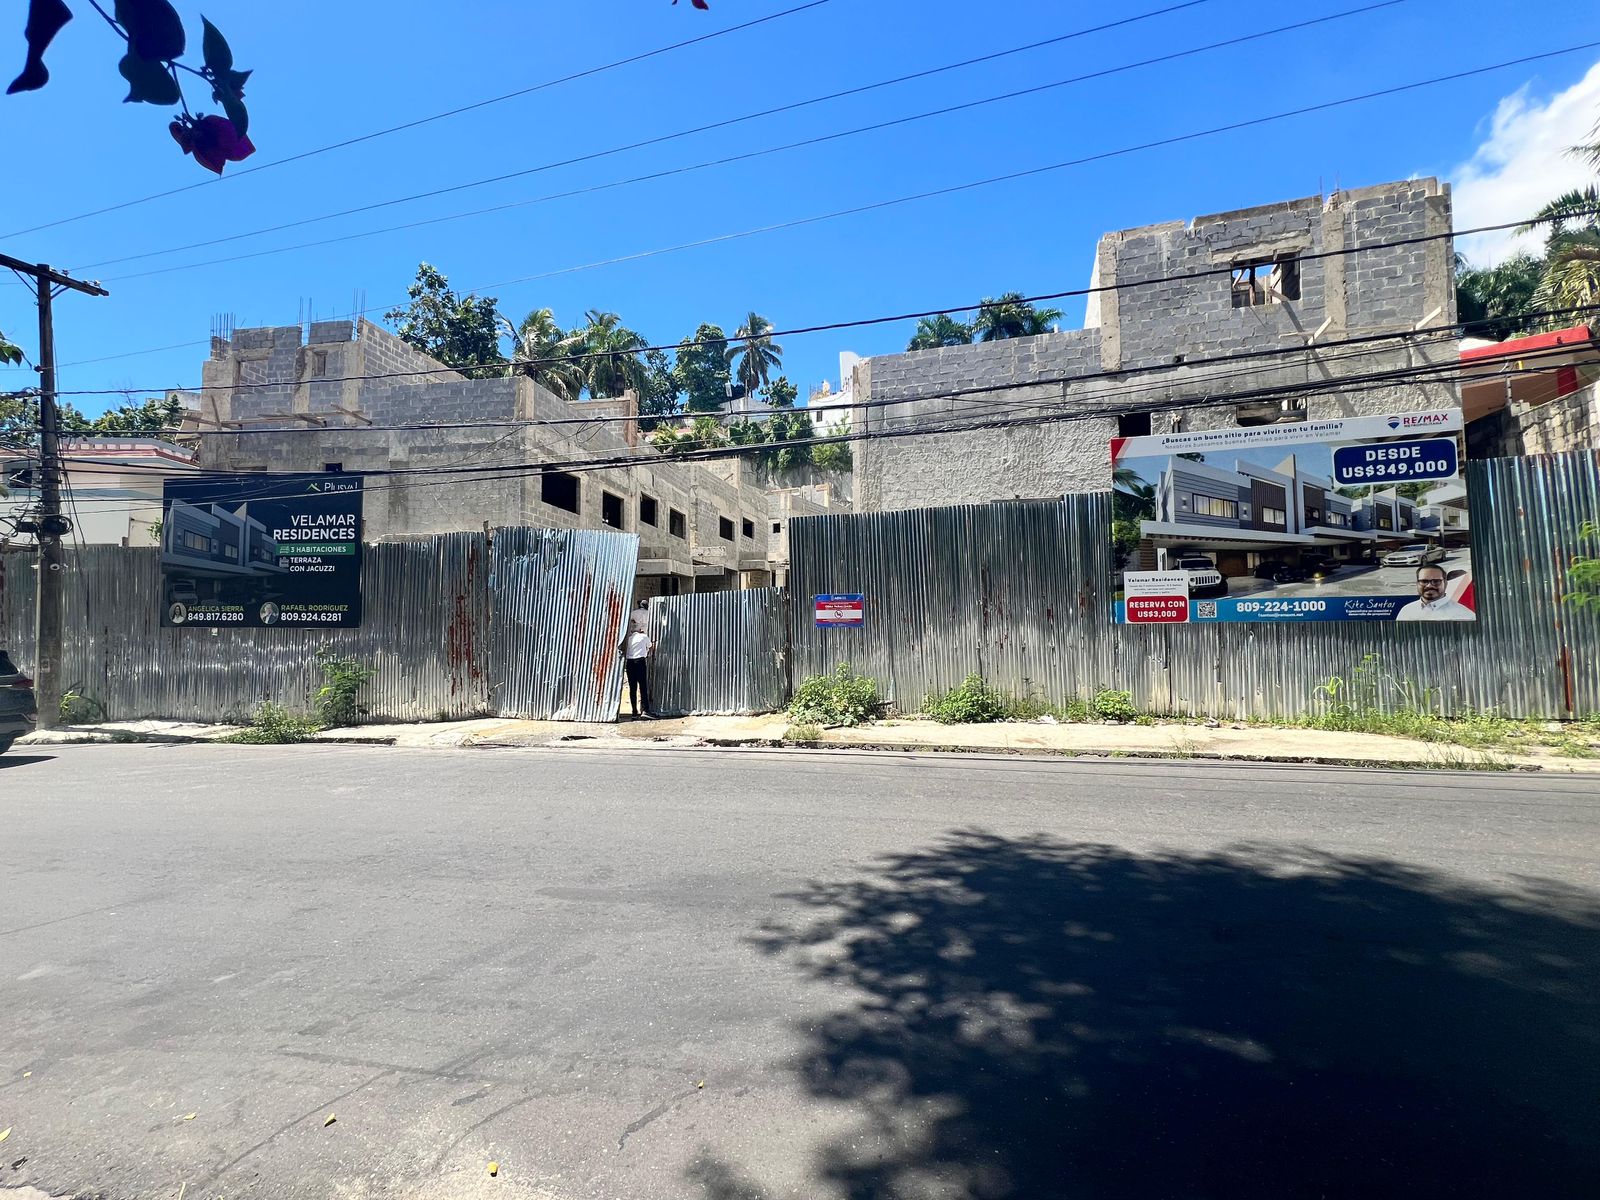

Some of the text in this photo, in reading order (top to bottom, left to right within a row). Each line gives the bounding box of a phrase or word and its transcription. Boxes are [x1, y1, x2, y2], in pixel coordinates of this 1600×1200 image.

[1403, 413, 1448, 425] RE/MAX
[1310, 422, 1343, 431] familia?
[1365, 446, 1421, 461] DESDE
[1342, 459, 1447, 478] US$349,000
[291, 514, 356, 526] VELAMAR
[273, 528, 355, 540] RESIDENCES
[1129, 600, 1185, 609] RESERVA CON
[1236, 600, 1326, 612] 809-224-1000
[1366, 598, 1396, 609] Santos
[187, 612, 244, 621] 849.817.6280
[281, 612, 342, 621] 809.924.6281
[1137, 610, 1177, 618] US$3,000
